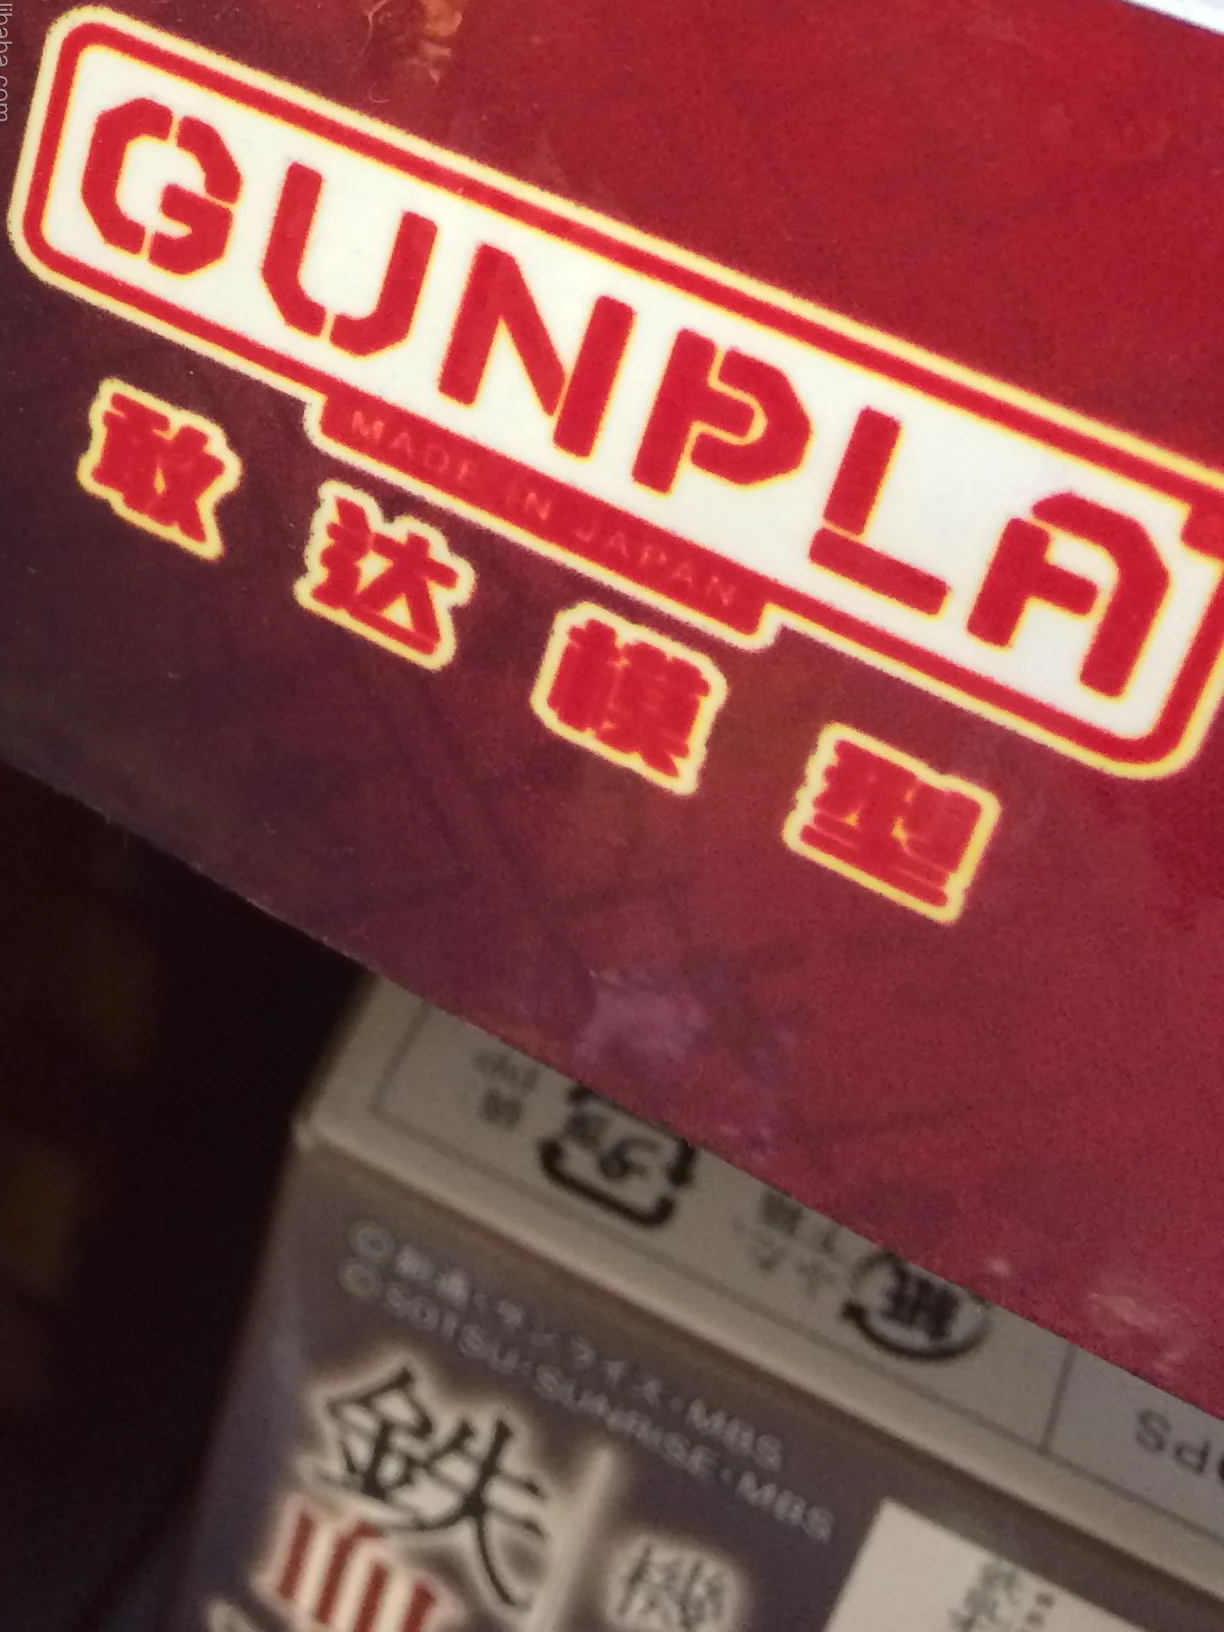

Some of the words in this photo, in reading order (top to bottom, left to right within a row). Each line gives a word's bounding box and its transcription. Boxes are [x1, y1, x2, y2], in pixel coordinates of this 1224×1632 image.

[81, 96, 1172, 699] GUNPLA
[350, 409, 475, 484] MADE
[507, 478, 552, 521] IN
[576, 514, 737, 607] JAPAN
